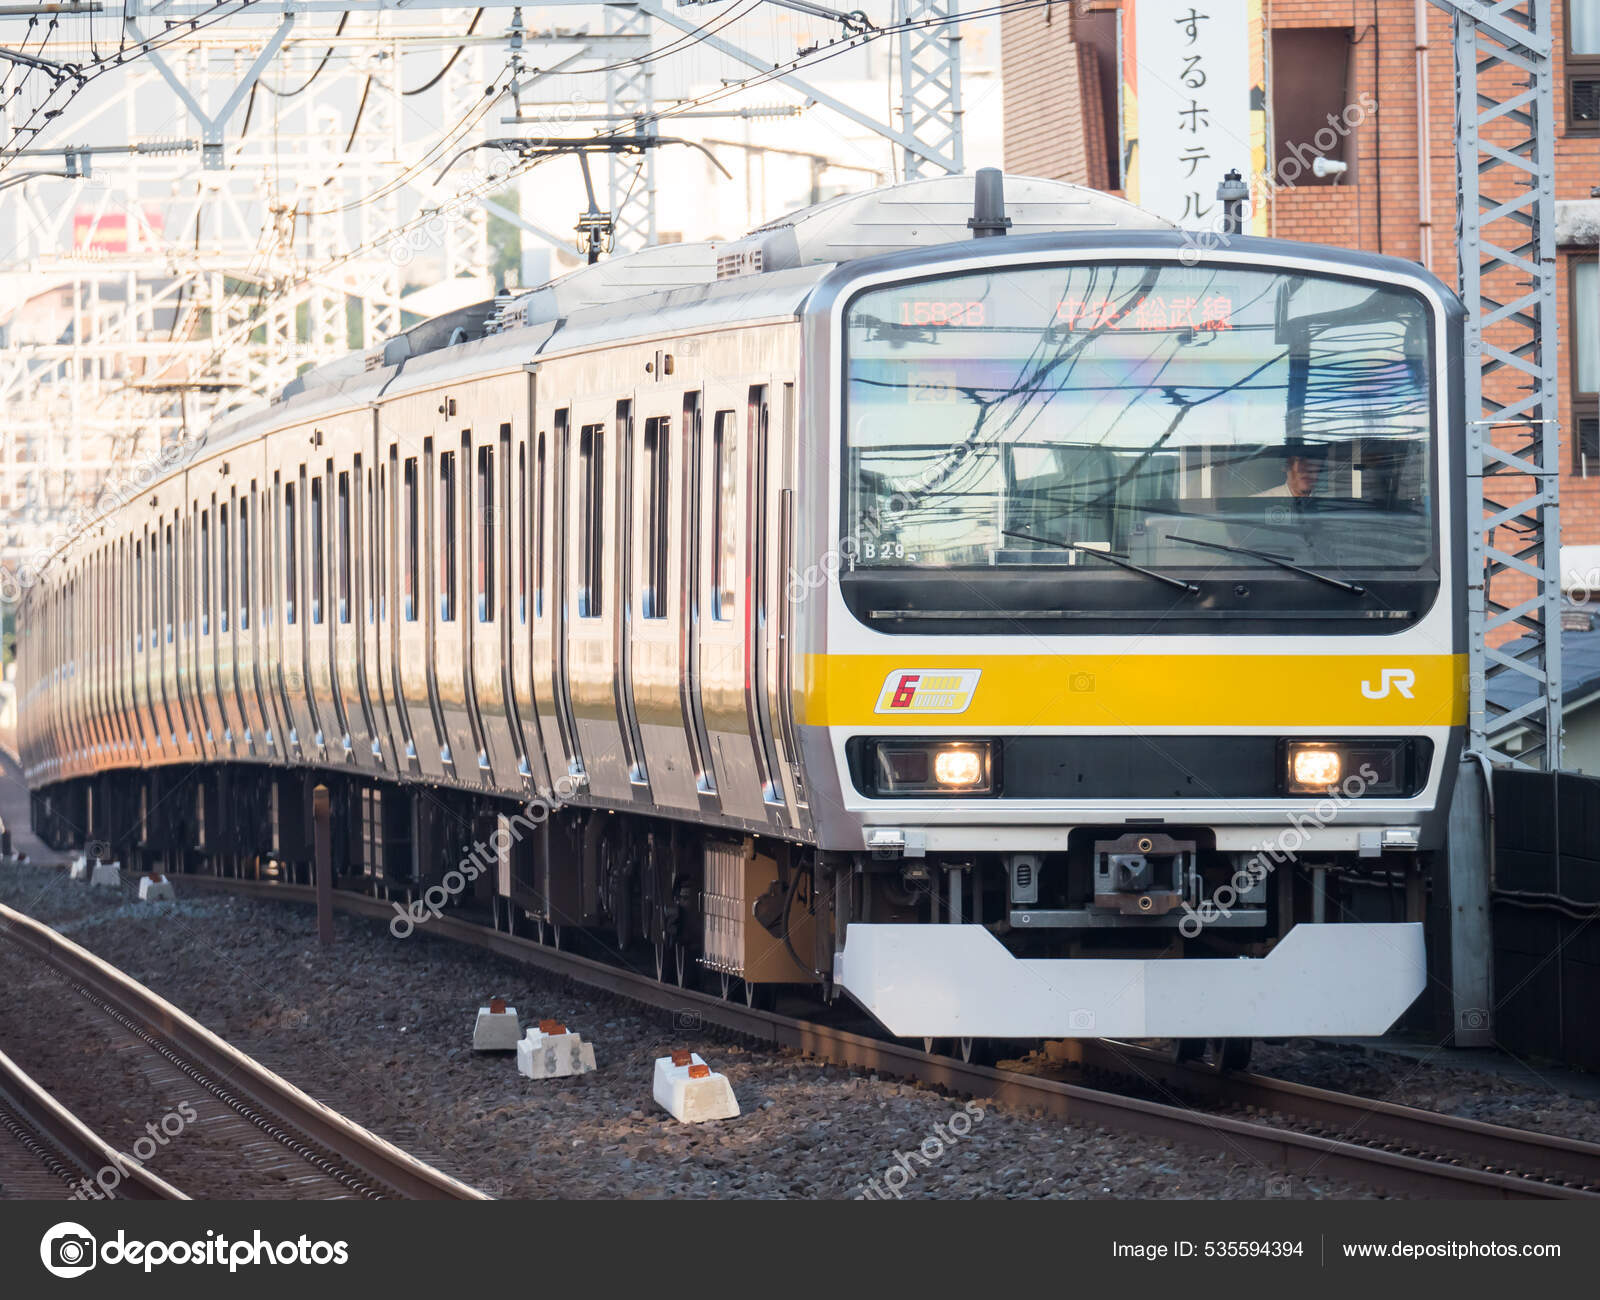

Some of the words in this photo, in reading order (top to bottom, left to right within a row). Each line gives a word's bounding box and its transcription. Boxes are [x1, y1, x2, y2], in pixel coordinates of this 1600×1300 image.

[1173, 7, 1214, 221] するホテル
[900, 301, 985, 327] 1583B
[890, 675, 920, 708] 6
[1361, 668, 1416, 700] JR
